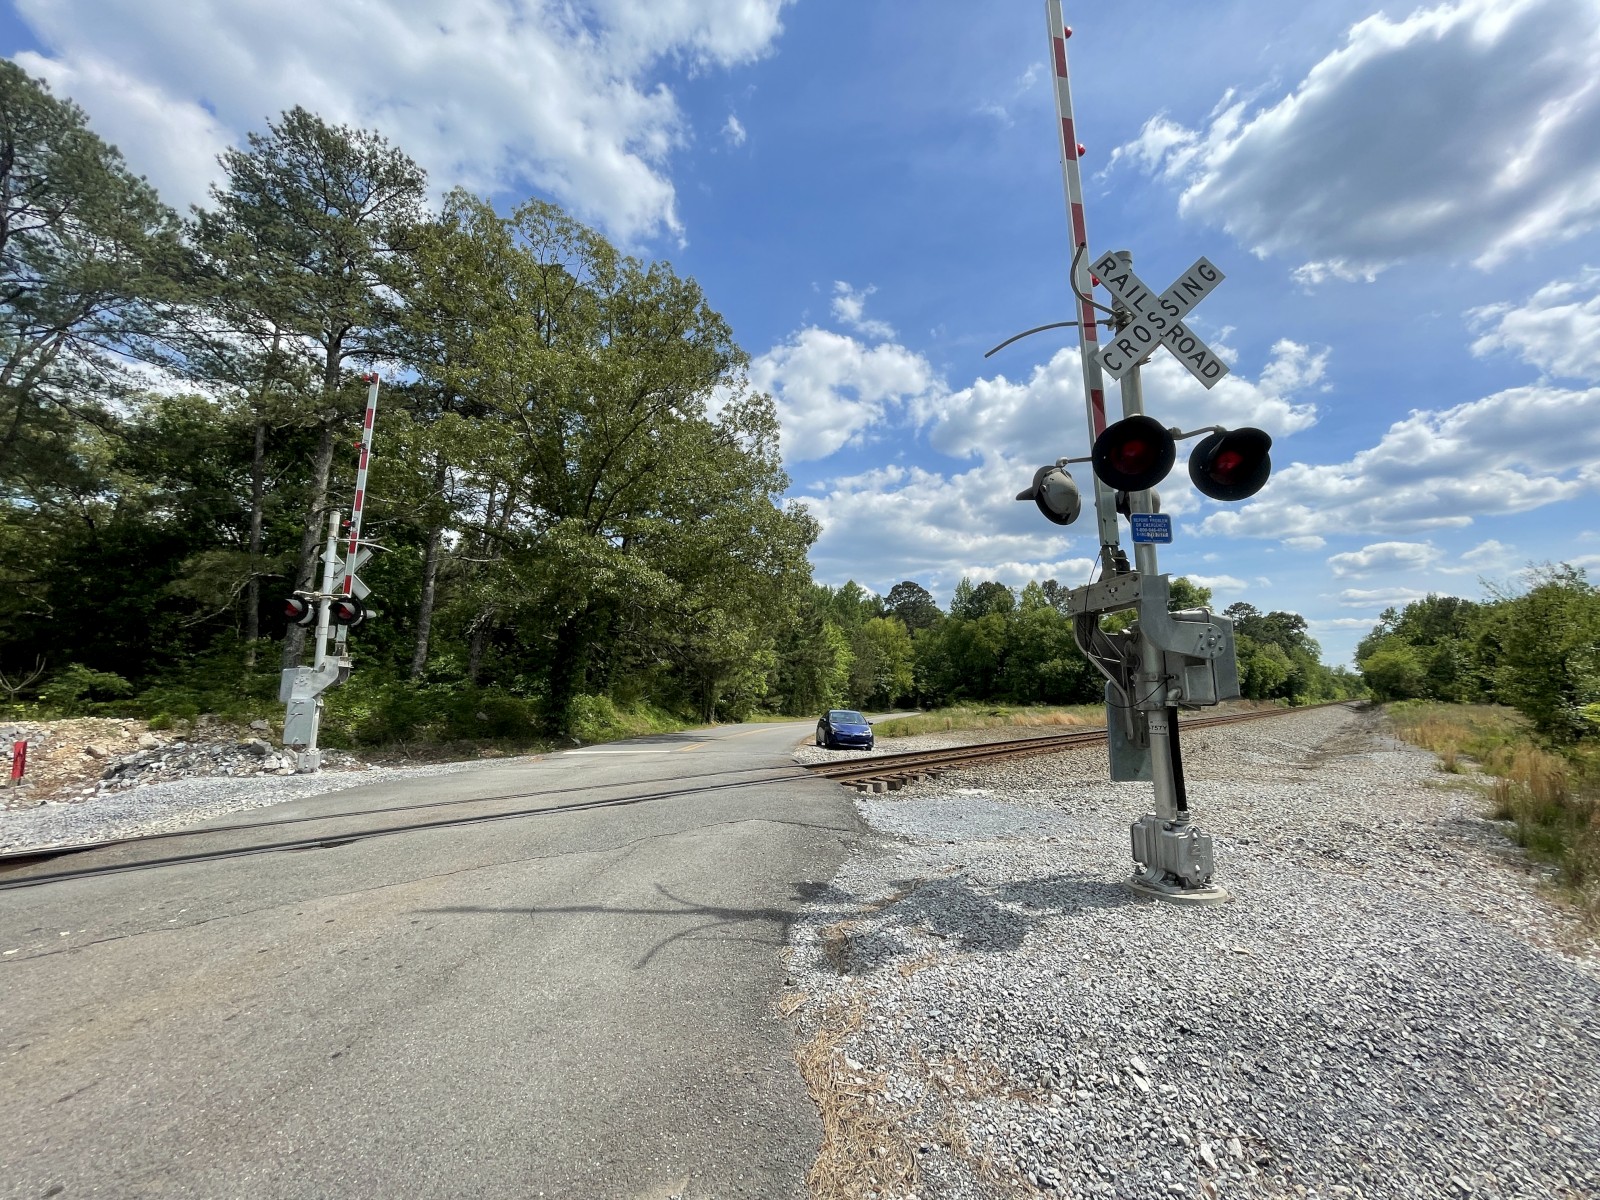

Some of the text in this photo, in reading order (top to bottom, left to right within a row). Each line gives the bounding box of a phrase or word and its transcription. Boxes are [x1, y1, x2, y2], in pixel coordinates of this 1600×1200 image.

[1096, 256, 1221, 379] RAIL ROAD
[1103, 264, 1217, 371] CROSSING
